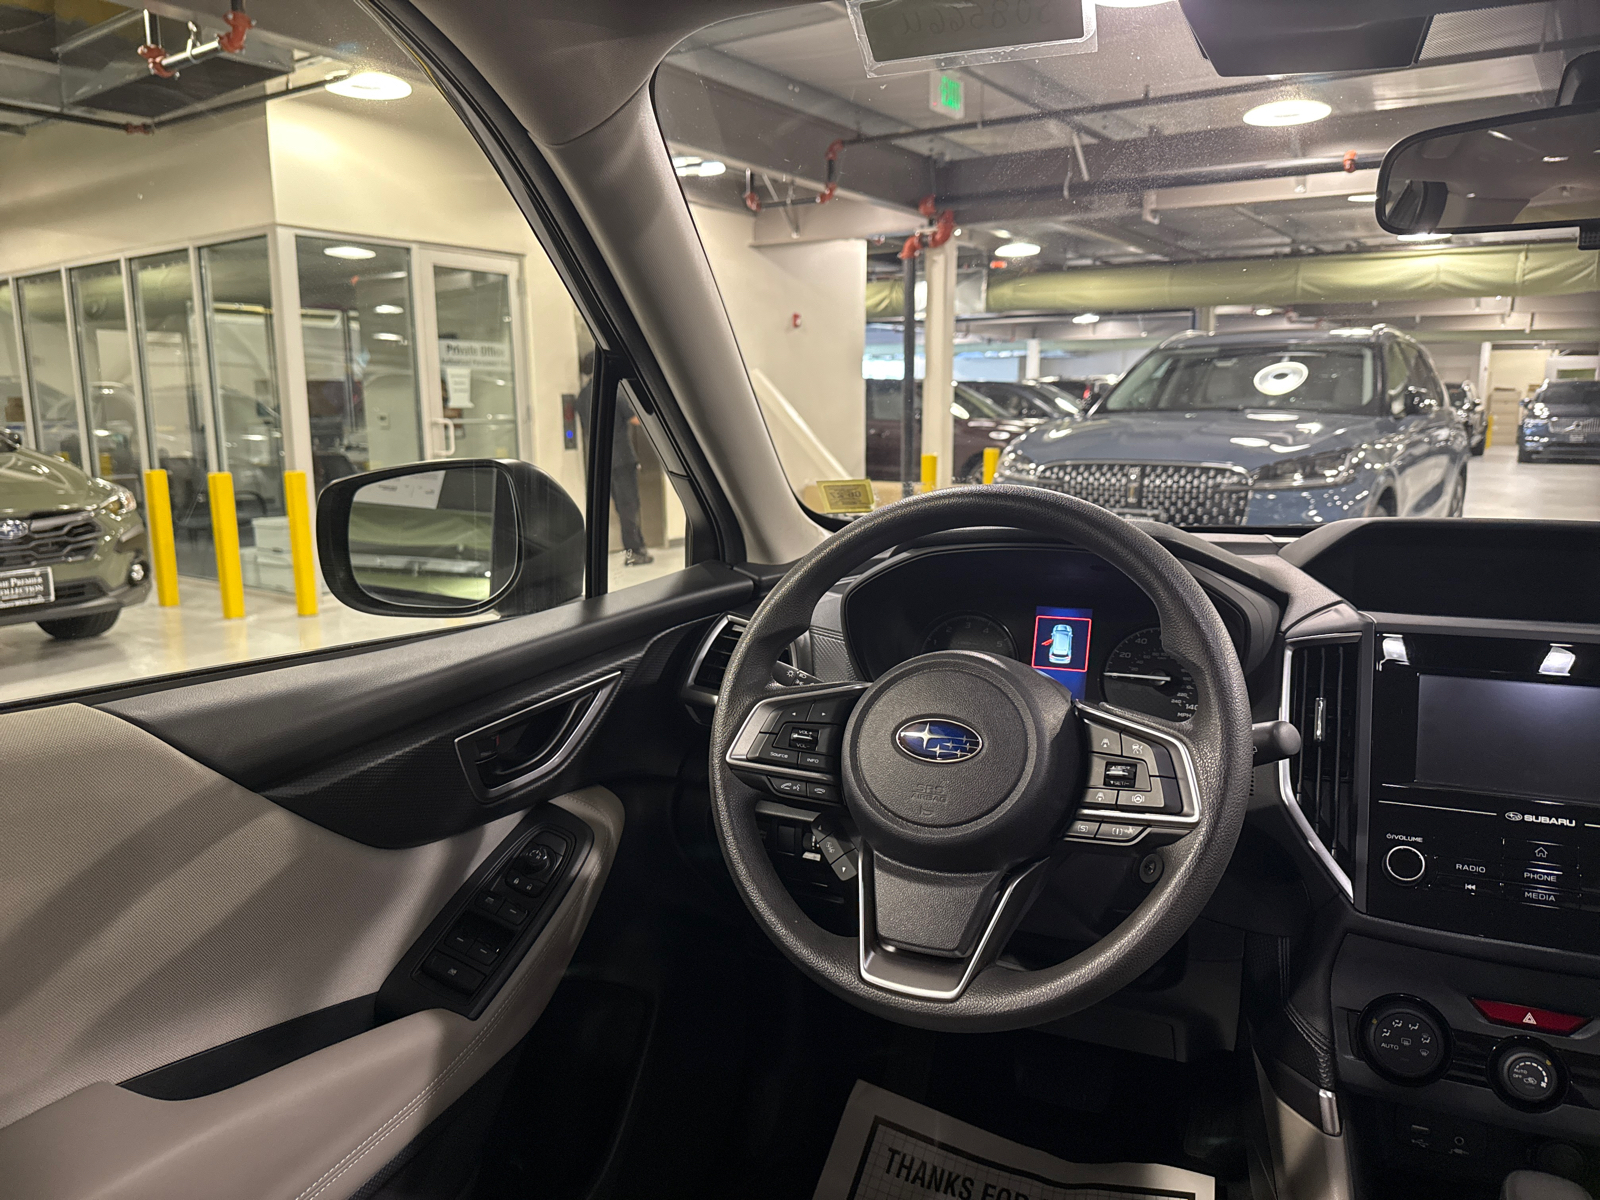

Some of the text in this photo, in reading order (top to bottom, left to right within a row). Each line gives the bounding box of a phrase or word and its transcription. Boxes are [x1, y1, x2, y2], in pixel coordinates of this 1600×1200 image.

[1119, 651, 1132, 659] 20
[1524, 814, 1576, 827] SUBARU
[1455, 863, 1486, 873] RADIO
[1523, 871, 1557, 882] PHONE
[1524, 891, 1556, 902] MEDIA
[1381, 1042, 1400, 1051] AUTO
[885, 1147, 975, 1200] THANKS
